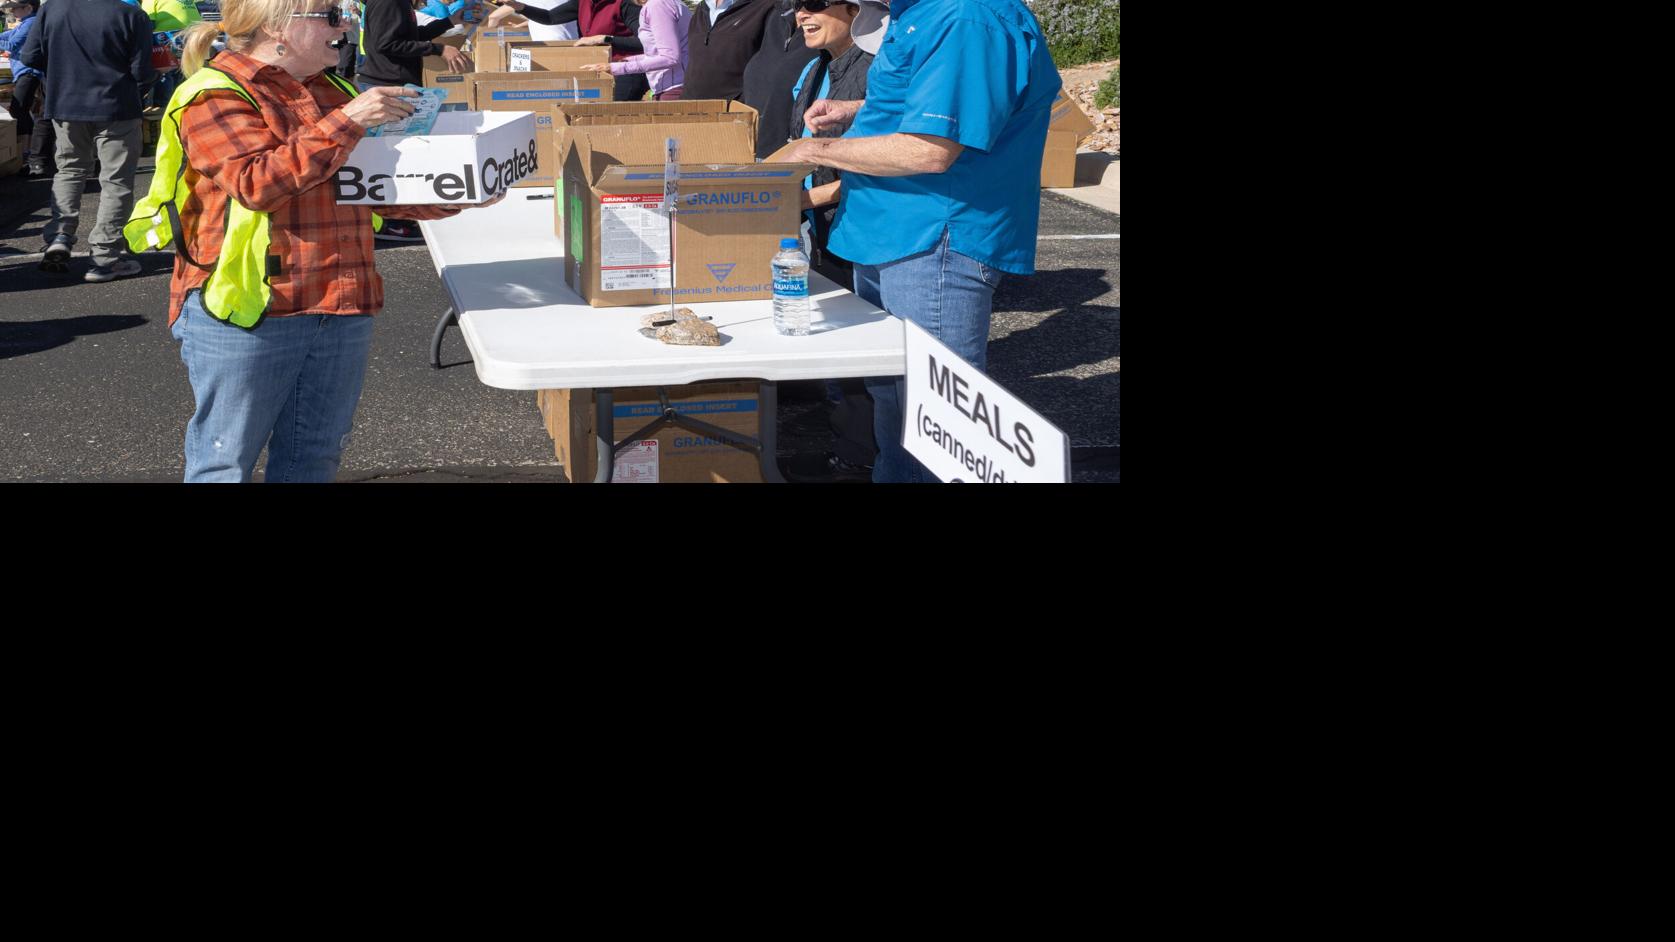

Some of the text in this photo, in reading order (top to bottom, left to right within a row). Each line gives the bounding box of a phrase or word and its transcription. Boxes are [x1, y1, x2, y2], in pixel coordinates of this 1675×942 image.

[716, 284, 761, 295] Medical
[917, 403, 1017, 483] (canned/
[928, 354, 1036, 468] MEALS
